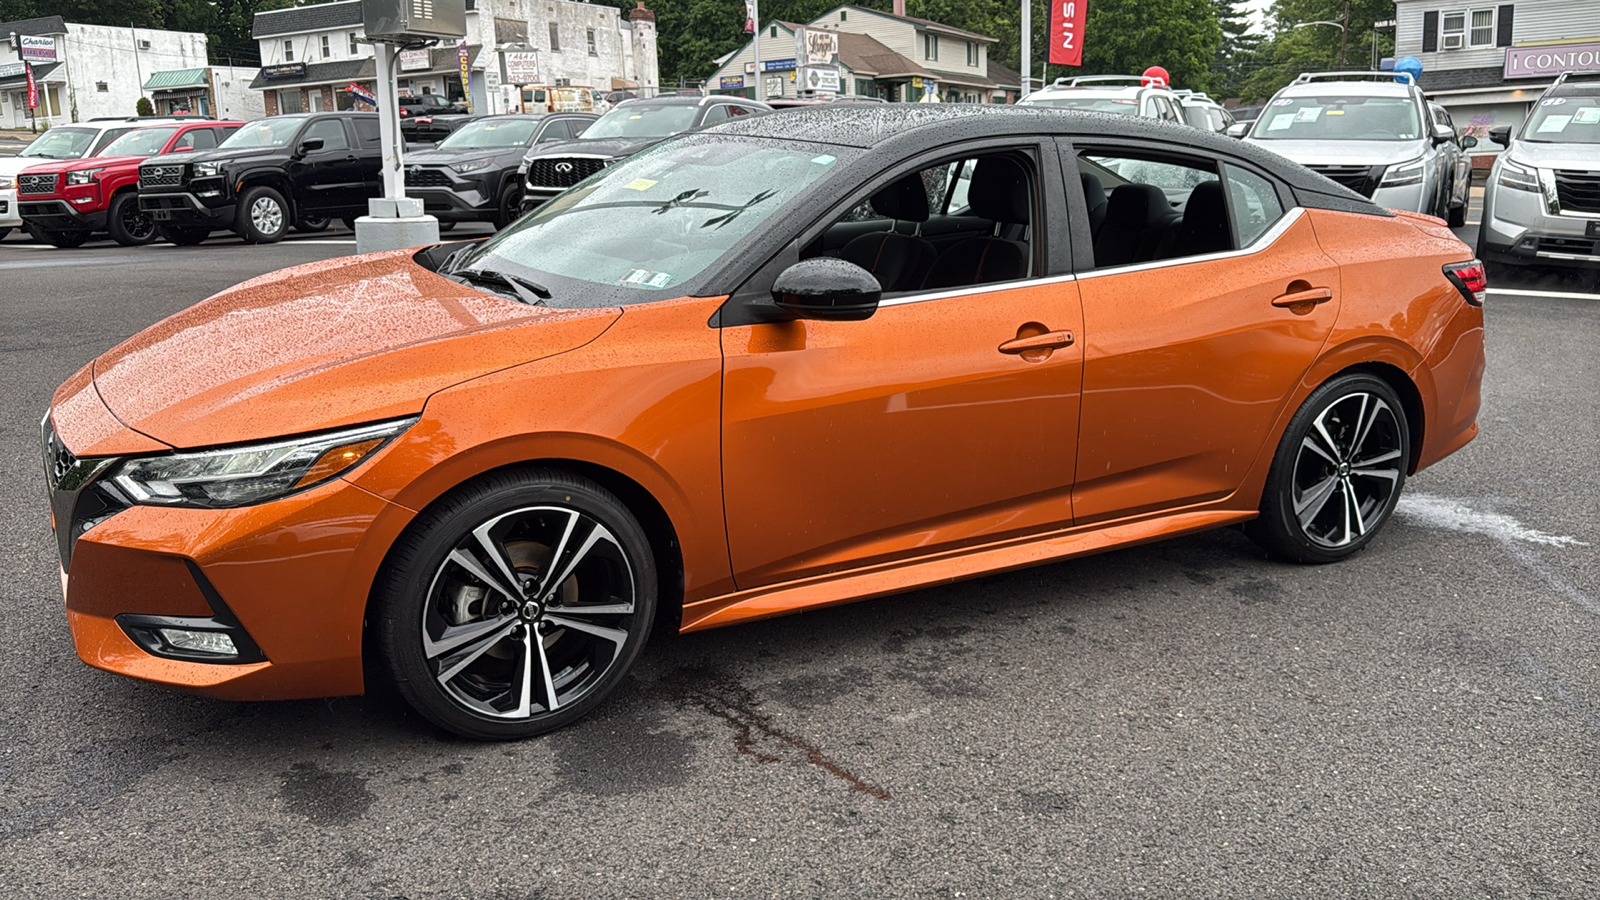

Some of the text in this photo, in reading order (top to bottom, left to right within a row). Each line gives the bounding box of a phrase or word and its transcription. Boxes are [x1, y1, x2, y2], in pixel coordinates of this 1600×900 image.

[1063, 2, 1075, 49] NIS
[22, 37, 54, 45] Charles
[507, 60, 536, 68] COMPUTERS
[1513, 53, 1518, 70] i
